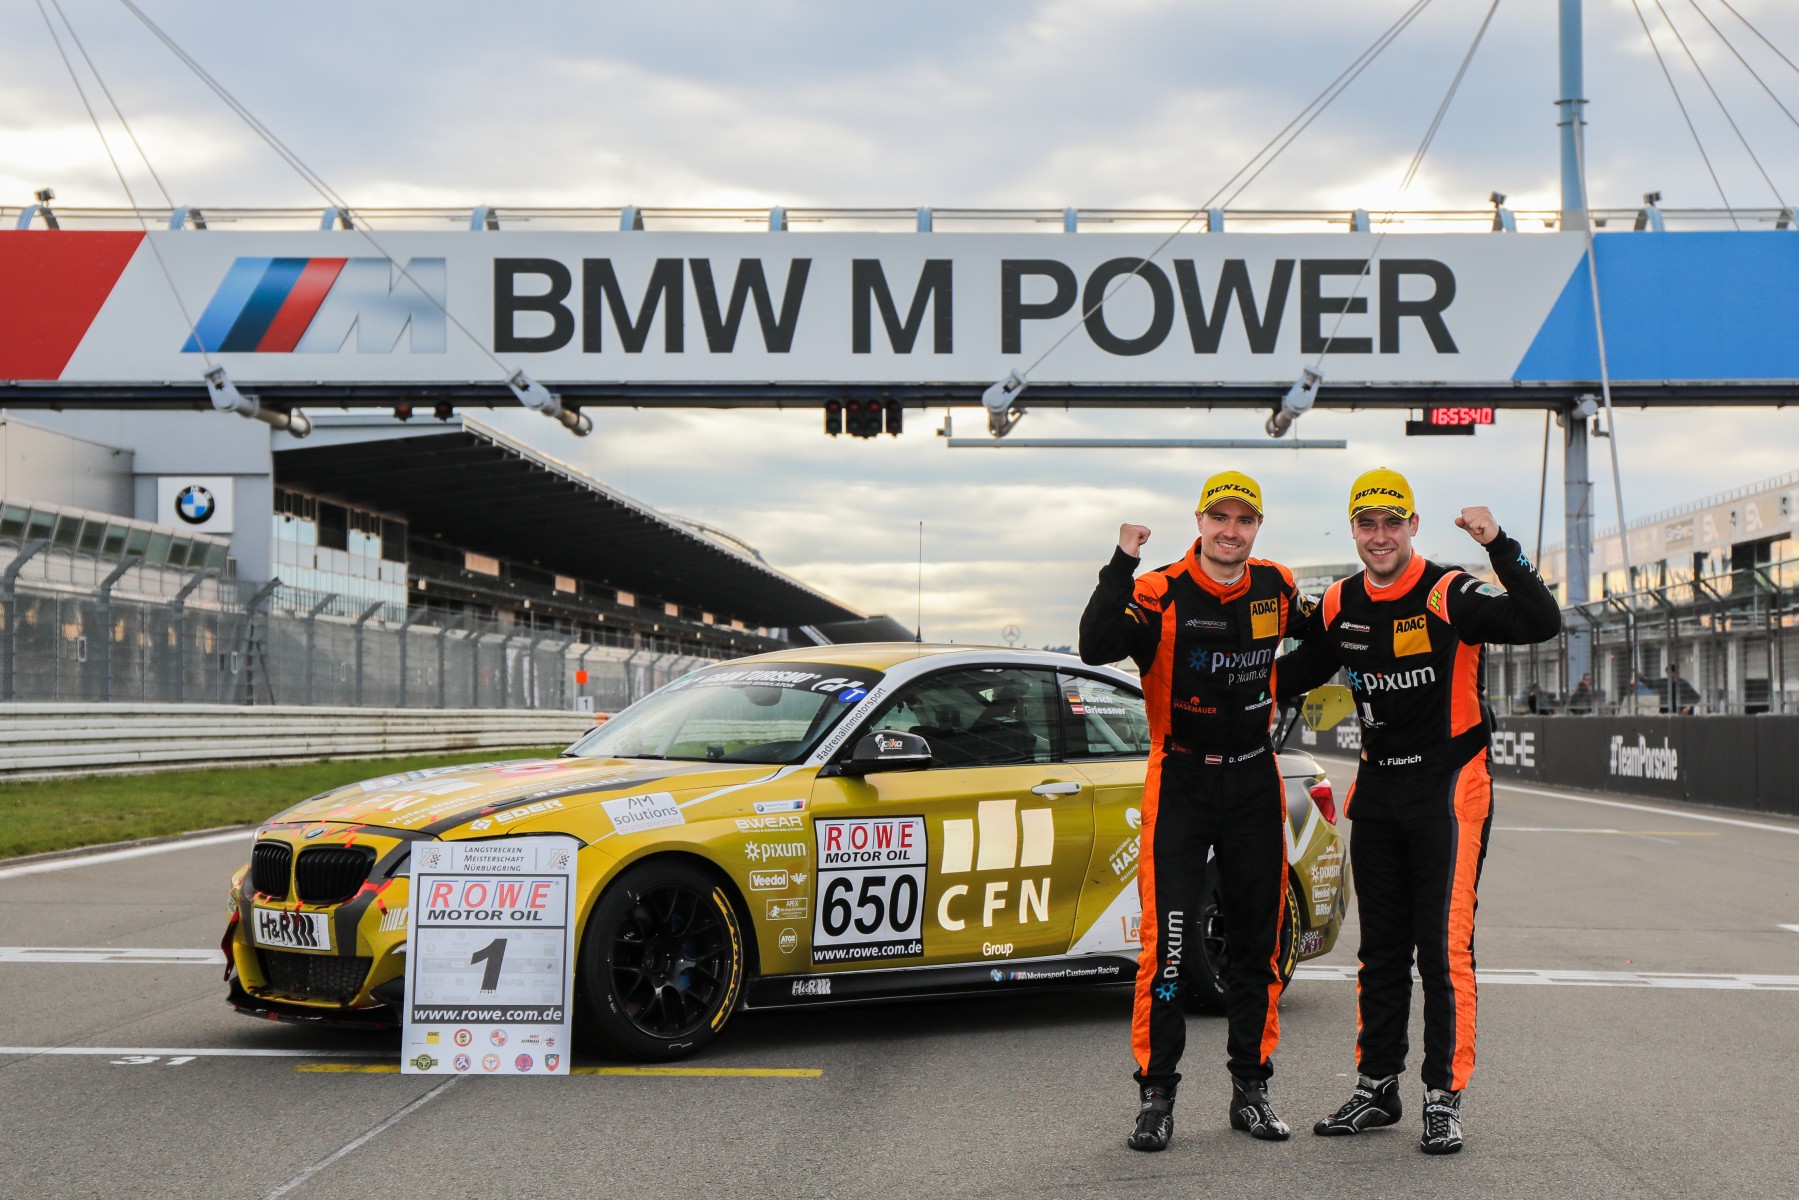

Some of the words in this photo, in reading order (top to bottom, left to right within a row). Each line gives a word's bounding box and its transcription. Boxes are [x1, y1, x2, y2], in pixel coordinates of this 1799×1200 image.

[493, 257, 812, 354] BMW
[851, 258, 954, 355] M
[1001, 256, 1461, 357] POWER
[1206, 484, 1257, 498] DUNLOP
[1354, 487, 1404, 501] DUNLOP
[1252, 601, 1276, 615] ADAC
[1396, 617, 1425, 633] ADAC
[743, 670, 815, 683] TURISMO
[1363, 666, 1436, 696] pixum
[1084, 706, 1125, 714] Griessner
[1173, 702, 1217, 714] HASENAUER
[815, 687, 886, 761] #adrenalinmotorsport
[1610, 734, 1678, 781] #TeamPorsche
[493, 800, 563, 822] EDER
[614, 806, 678, 825] solutions
[735, 816, 803, 829] BWEAR
[825, 823, 914, 851] ROWE
[464, 846, 522, 854] LANGSTRECKEN
[761, 842, 806, 863] pixum
[825, 851, 882, 863] MOTOR
[886, 850, 911, 861] OIL
[464, 855, 524, 863] MEISTERSCHAFT
[463, 863, 521, 872] NÜRBURGRING
[752, 873, 786, 887] Veedol
[428, 882, 551, 908] ROWE
[822, 874, 919, 937] 650
[427, 910, 502, 921] MOTOR
[510, 910, 542, 921] OIL
[813, 941, 922, 961] www.rowe.com.de
[982, 942, 1014, 956] Group
[1163, 910, 1184, 979] pixum
[470, 938, 507, 992] 1
[1027, 971, 1065, 980] Motorsport
[1066, 969, 1097, 977] Customer
[1097, 966, 1120, 975] Racing
[414, 1008, 562, 1021] www.rowe.com.de
